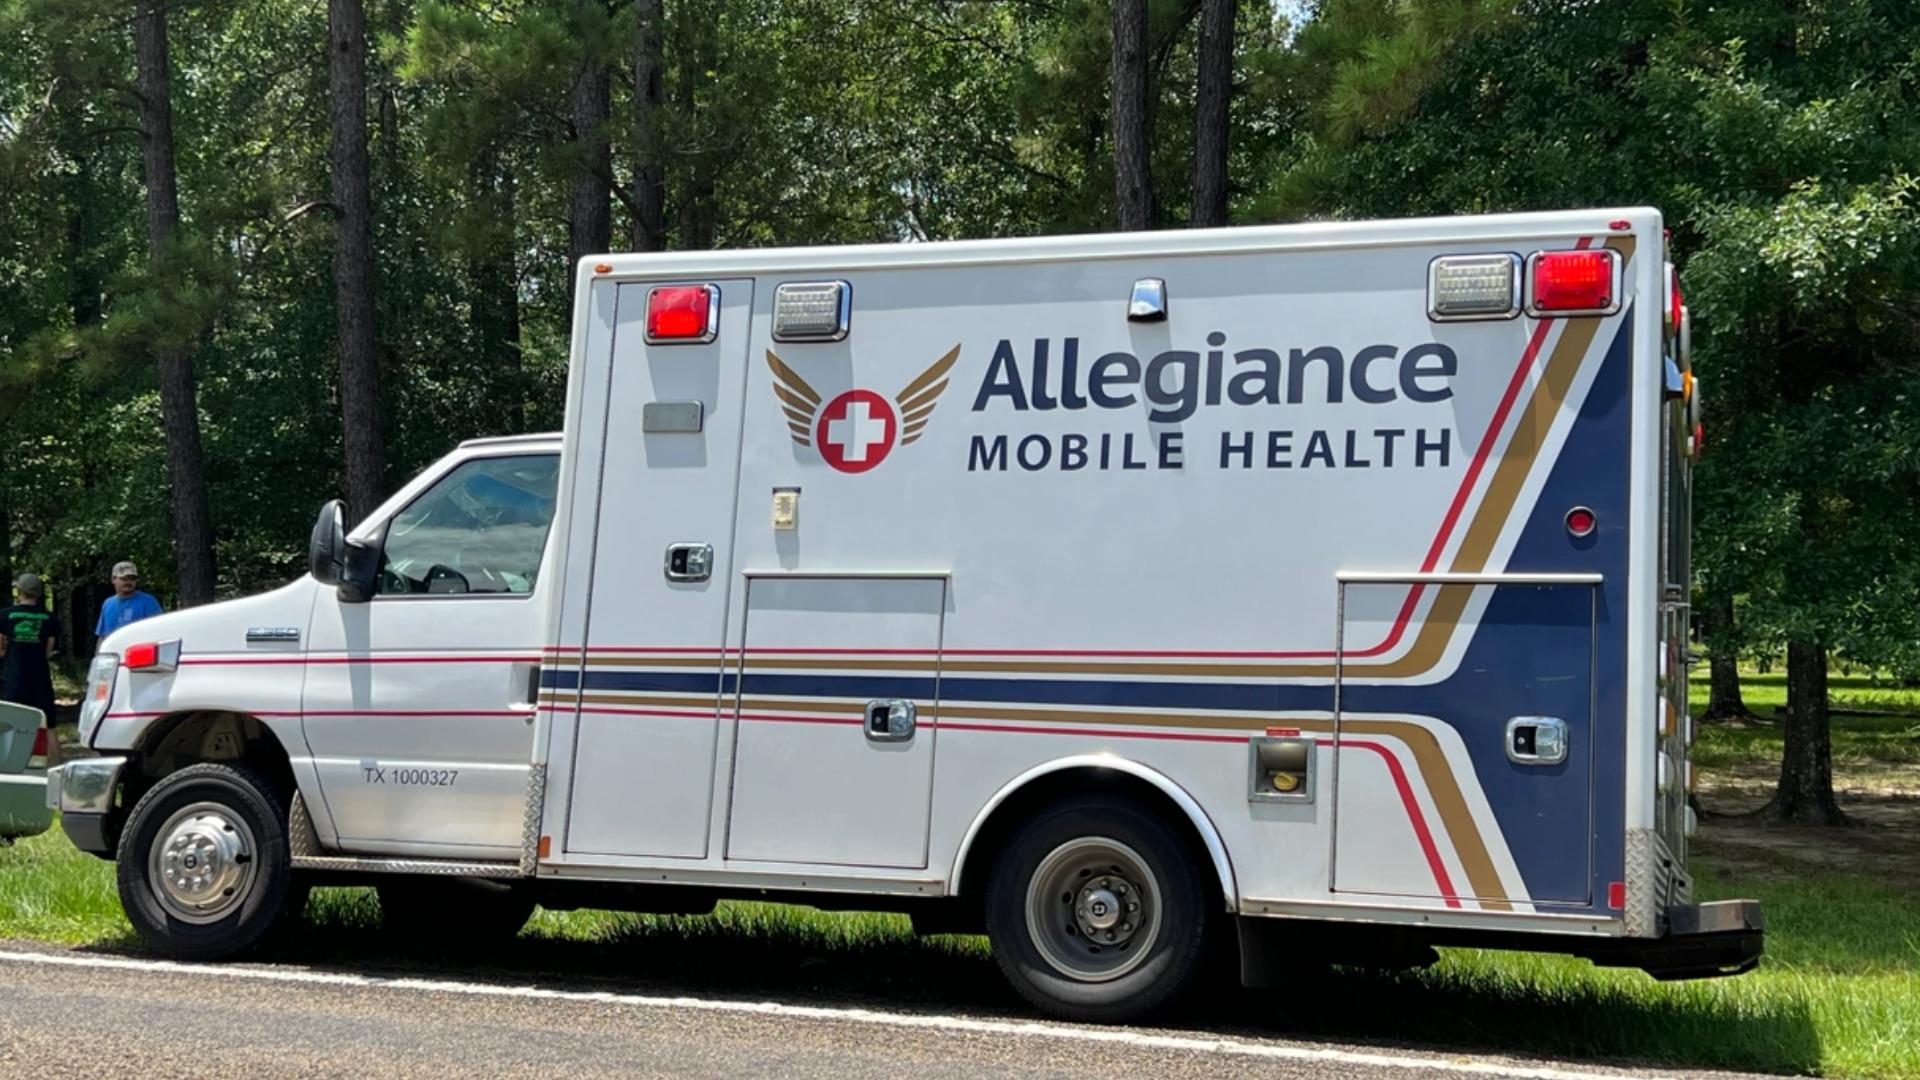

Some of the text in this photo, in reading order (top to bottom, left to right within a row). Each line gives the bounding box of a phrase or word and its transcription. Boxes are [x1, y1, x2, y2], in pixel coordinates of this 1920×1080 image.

[971, 331, 1458, 424] Allegiance
[967, 428, 1451, 472] MOBILE HEALTH
[364, 767, 459, 786] TX 1000327
